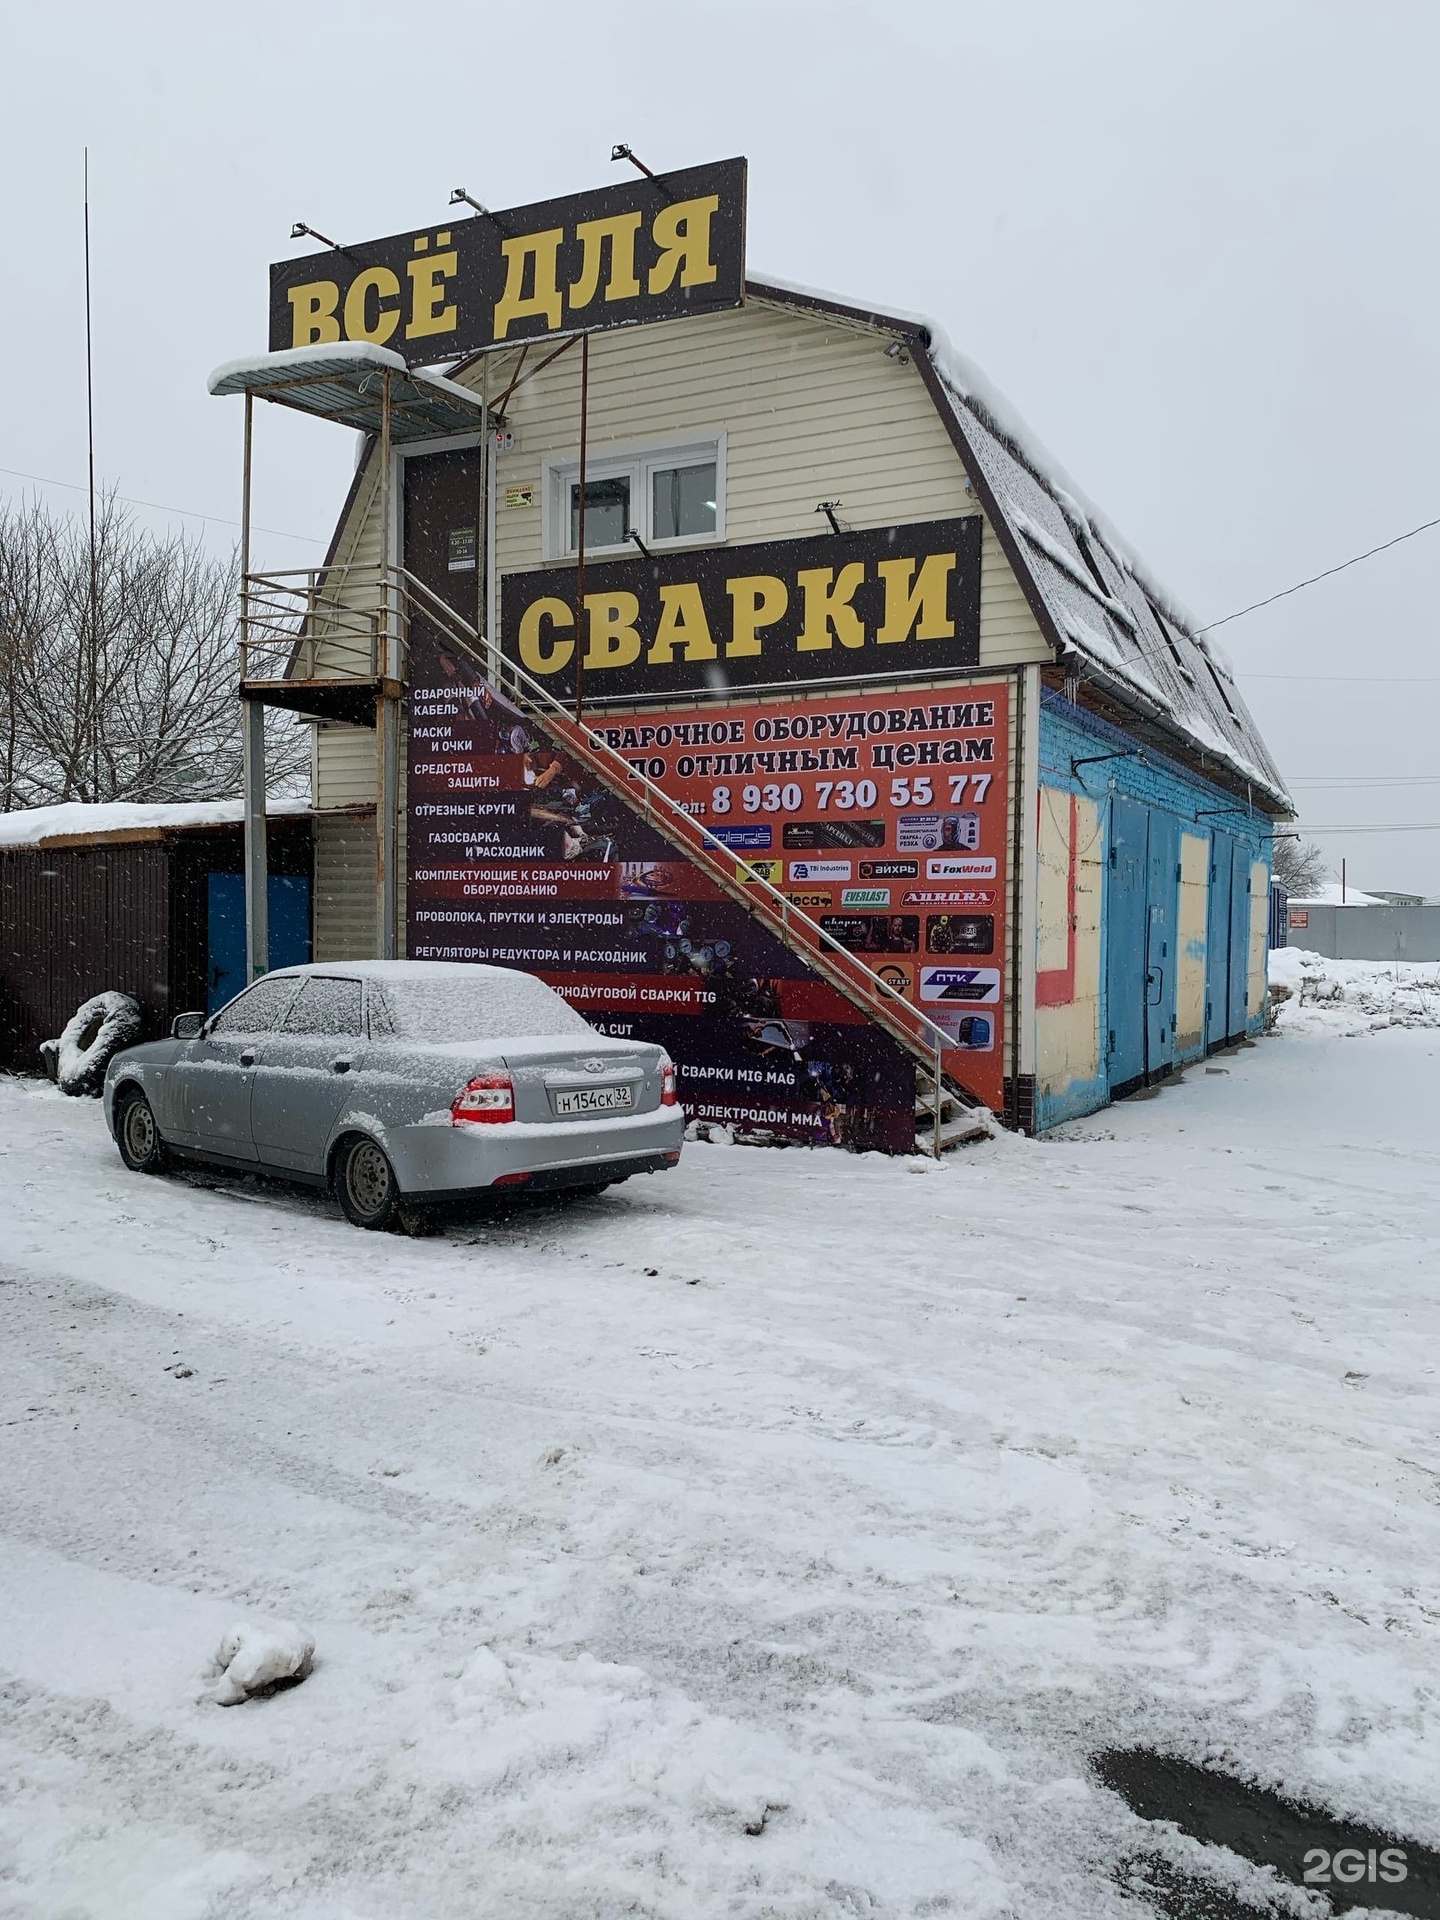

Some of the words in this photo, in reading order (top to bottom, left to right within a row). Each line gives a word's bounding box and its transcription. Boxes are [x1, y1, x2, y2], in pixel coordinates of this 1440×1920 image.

[287, 232, 458, 349] ВСЁ
[493, 194, 720, 340] ДЛЯ
[518, 552, 957, 675] СВАРКИ
[414, 684, 486, 701] СВАРОЧНЫЙ
[413, 704, 459, 716] КАБЕЛЬ
[588, 720, 745, 751] СВАРОЧНОЕ
[753, 700, 995, 742] ОБОРУДОВАНИЕ
[413, 727, 452, 737] МАСКИ
[431, 742, 439, 752] И
[442, 740, 473, 752] ОЧКИ
[627, 757, 666, 780] ПО
[676, 746, 860, 778] ОТЛИЧНЫМ
[871, 738, 995, 774] ценам
[414, 763, 473, 775] СРЕДСТВА
[448, 776, 500, 789] ЗАЩИТЫ
[711, 786, 731, 814] 8
[742, 783, 803, 813] 930
[815, 779, 879, 810] 730
[890, 777, 933, 807] 55
[949, 773, 992, 804] 77
[415, 804, 475, 816] ОТРЕЗНЫЕ
[478, 804, 516, 816] КРУГИ
[429, 832, 500, 844] ГАЗОСВАРКА
[466, 847, 474, 857] И
[476, 846, 545, 858] РАСХОДНИК
[819, 864, 849, 872] Industries
[942, 865, 993, 874] FoxWeld
[415, 870, 518, 882] КОМПЛЕКТУЮЩИЕ
[521, 871, 529, 880] К
[531, 870, 611, 881] СВАРОЧНОМУ
[463, 884, 558, 896] ОБОРУДОВАНИЮ
[787, 893, 821, 906] deca
[844, 891, 889, 902] EVERLAST
[905, 892, 991, 902] AURORA
[416, 911, 486, 924] ПРОВОЛОКА,
[489, 912, 535, 924] ПРУТКИ
[538, 913, 546, 923] И
[549, 913, 623, 925] ЭЛЕКТРОДЫ
[416, 947, 489, 959] РЕГУЛЯТОРЫ
[492, 948, 560, 960] РЕДУКТОРА
[563, 950, 571, 960] И
[575, 950, 648, 963] РАСХОДНИК
[887, 978, 911, 986] START
[935, 974, 967, 982] ПТК
[551, 985, 637, 1000] ОНОДУГОВОЙ
[640, 988, 691, 1001] СВАРКИ
[694, 991, 717, 1003] TIG
[609, 1023, 634, 1036] CUT
[681, 1066, 734, 1080] СВАРКИ
[737, 1069, 763, 1083] MIG
[766, 1071, 796, 1085] MAG
[615, 1088, 627, 1100] 32
[698, 1104, 788, 1124] ЭЛЕКТРОДОМ
